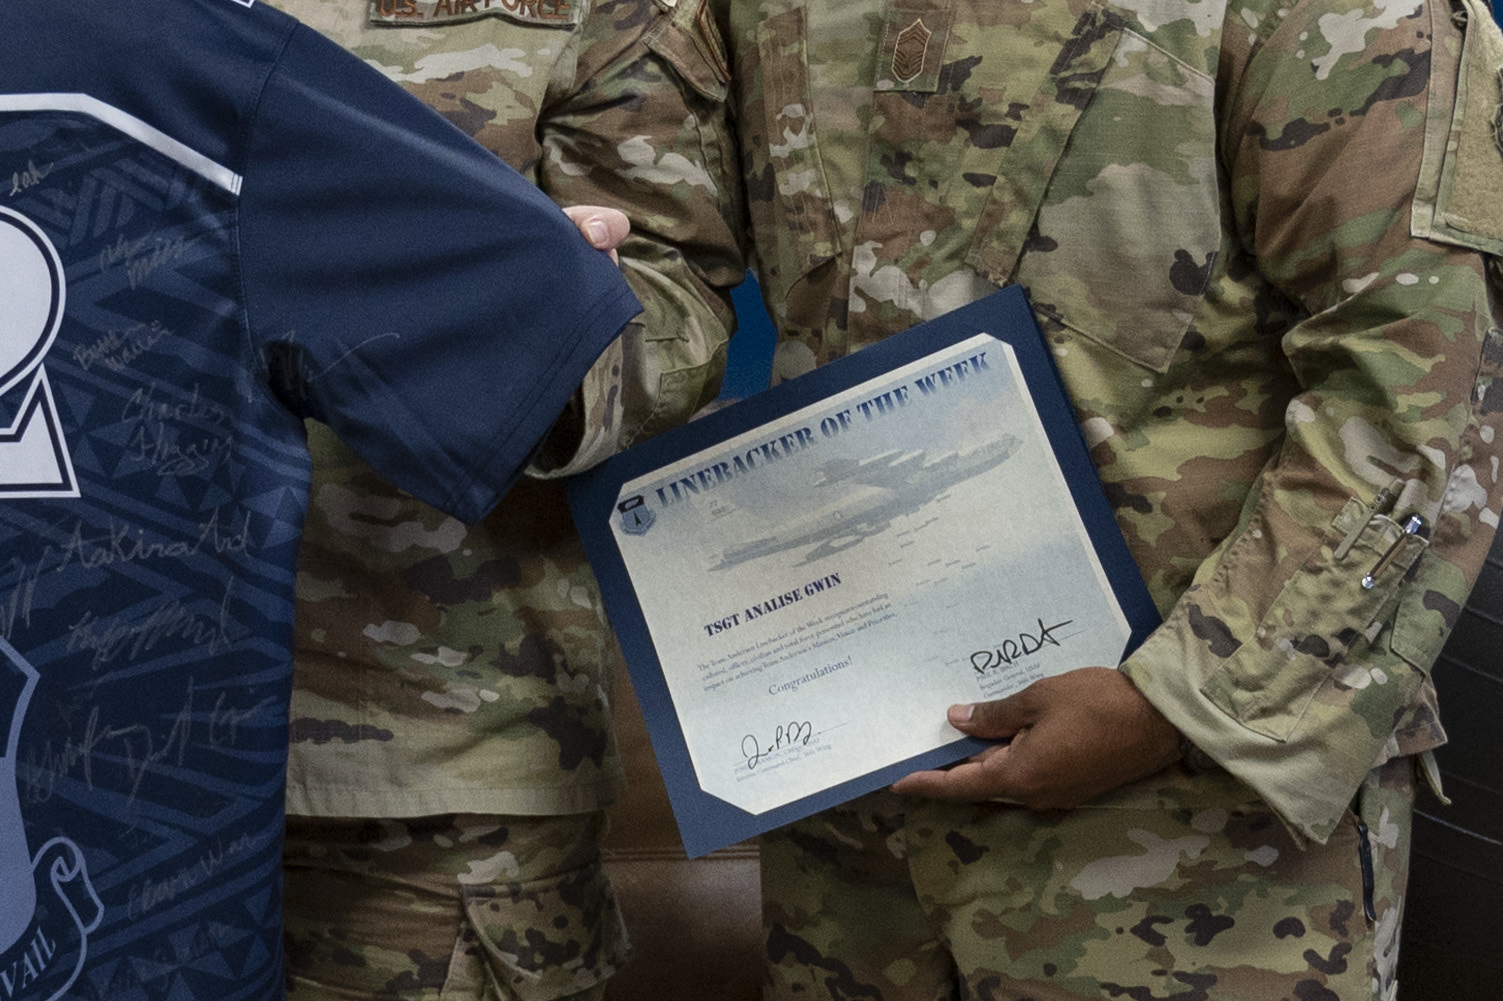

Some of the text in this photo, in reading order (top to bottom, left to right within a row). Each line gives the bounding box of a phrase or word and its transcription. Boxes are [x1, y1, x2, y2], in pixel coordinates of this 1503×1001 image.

[653, 351, 993, 508] LINEBACKER OF THE WEEK
[703, 571, 842, 637] TSGT ANALISE GWIN
[767, 654, 855, 700] Congratulations!
